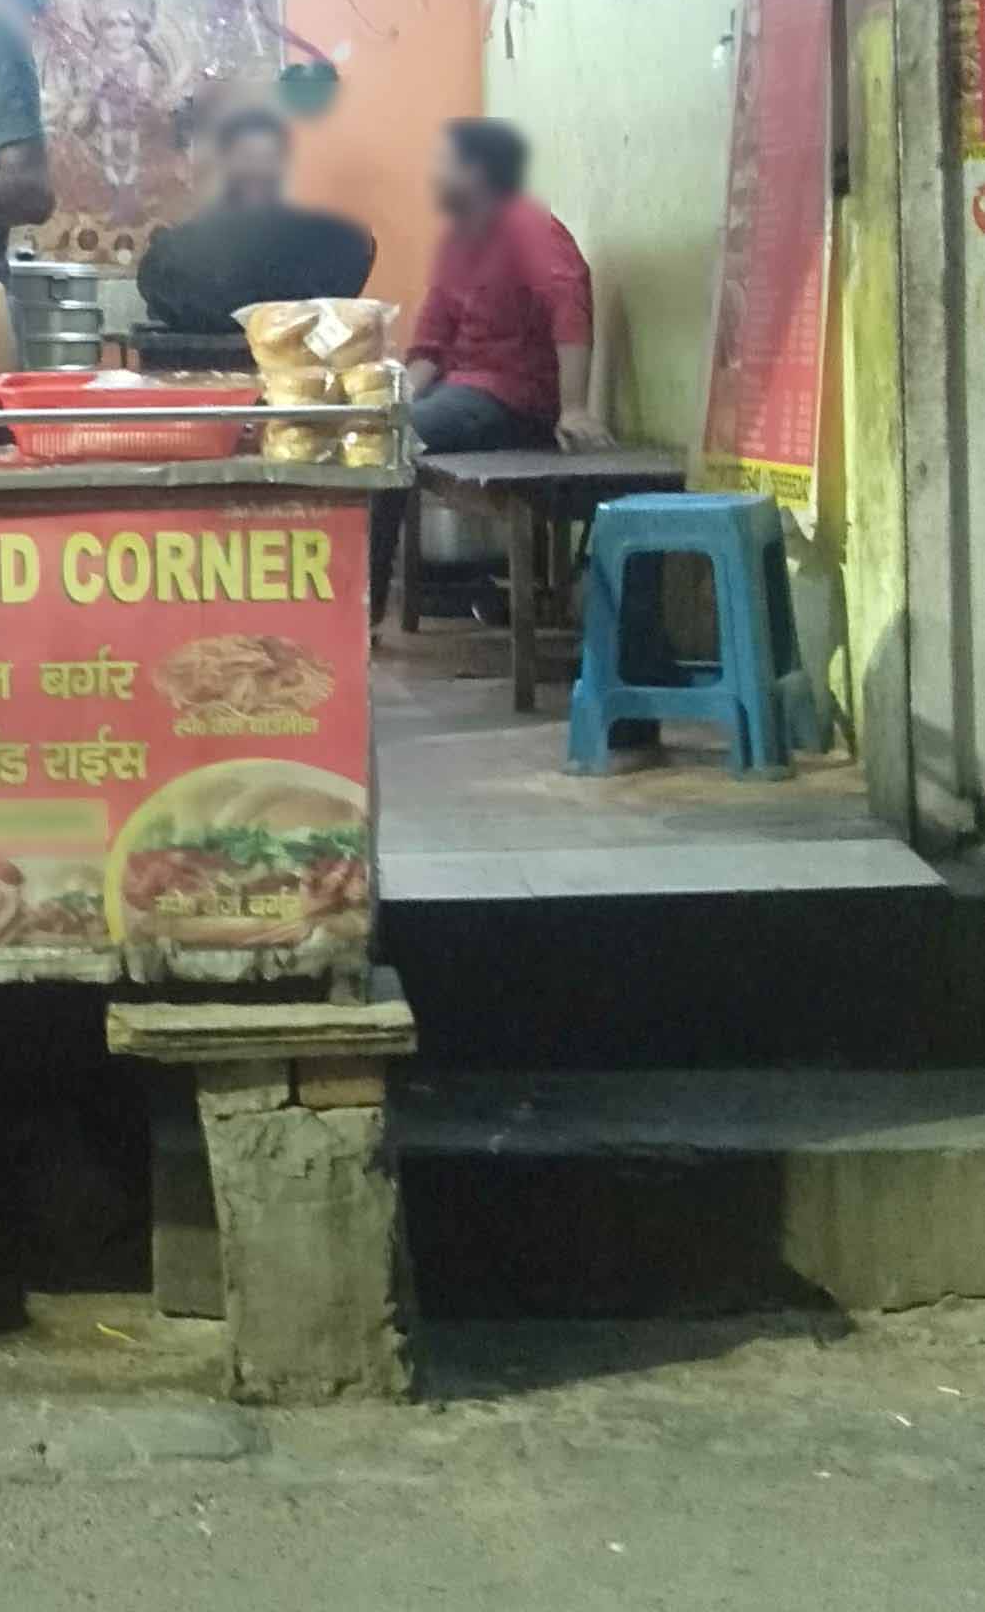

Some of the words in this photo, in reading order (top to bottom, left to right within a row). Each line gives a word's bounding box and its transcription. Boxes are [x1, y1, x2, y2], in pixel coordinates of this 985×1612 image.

[63, 529, 335, 604] CORNER
[39, 645, 139, 701] बर्गर
[42, 725, 149, 785] राईस
